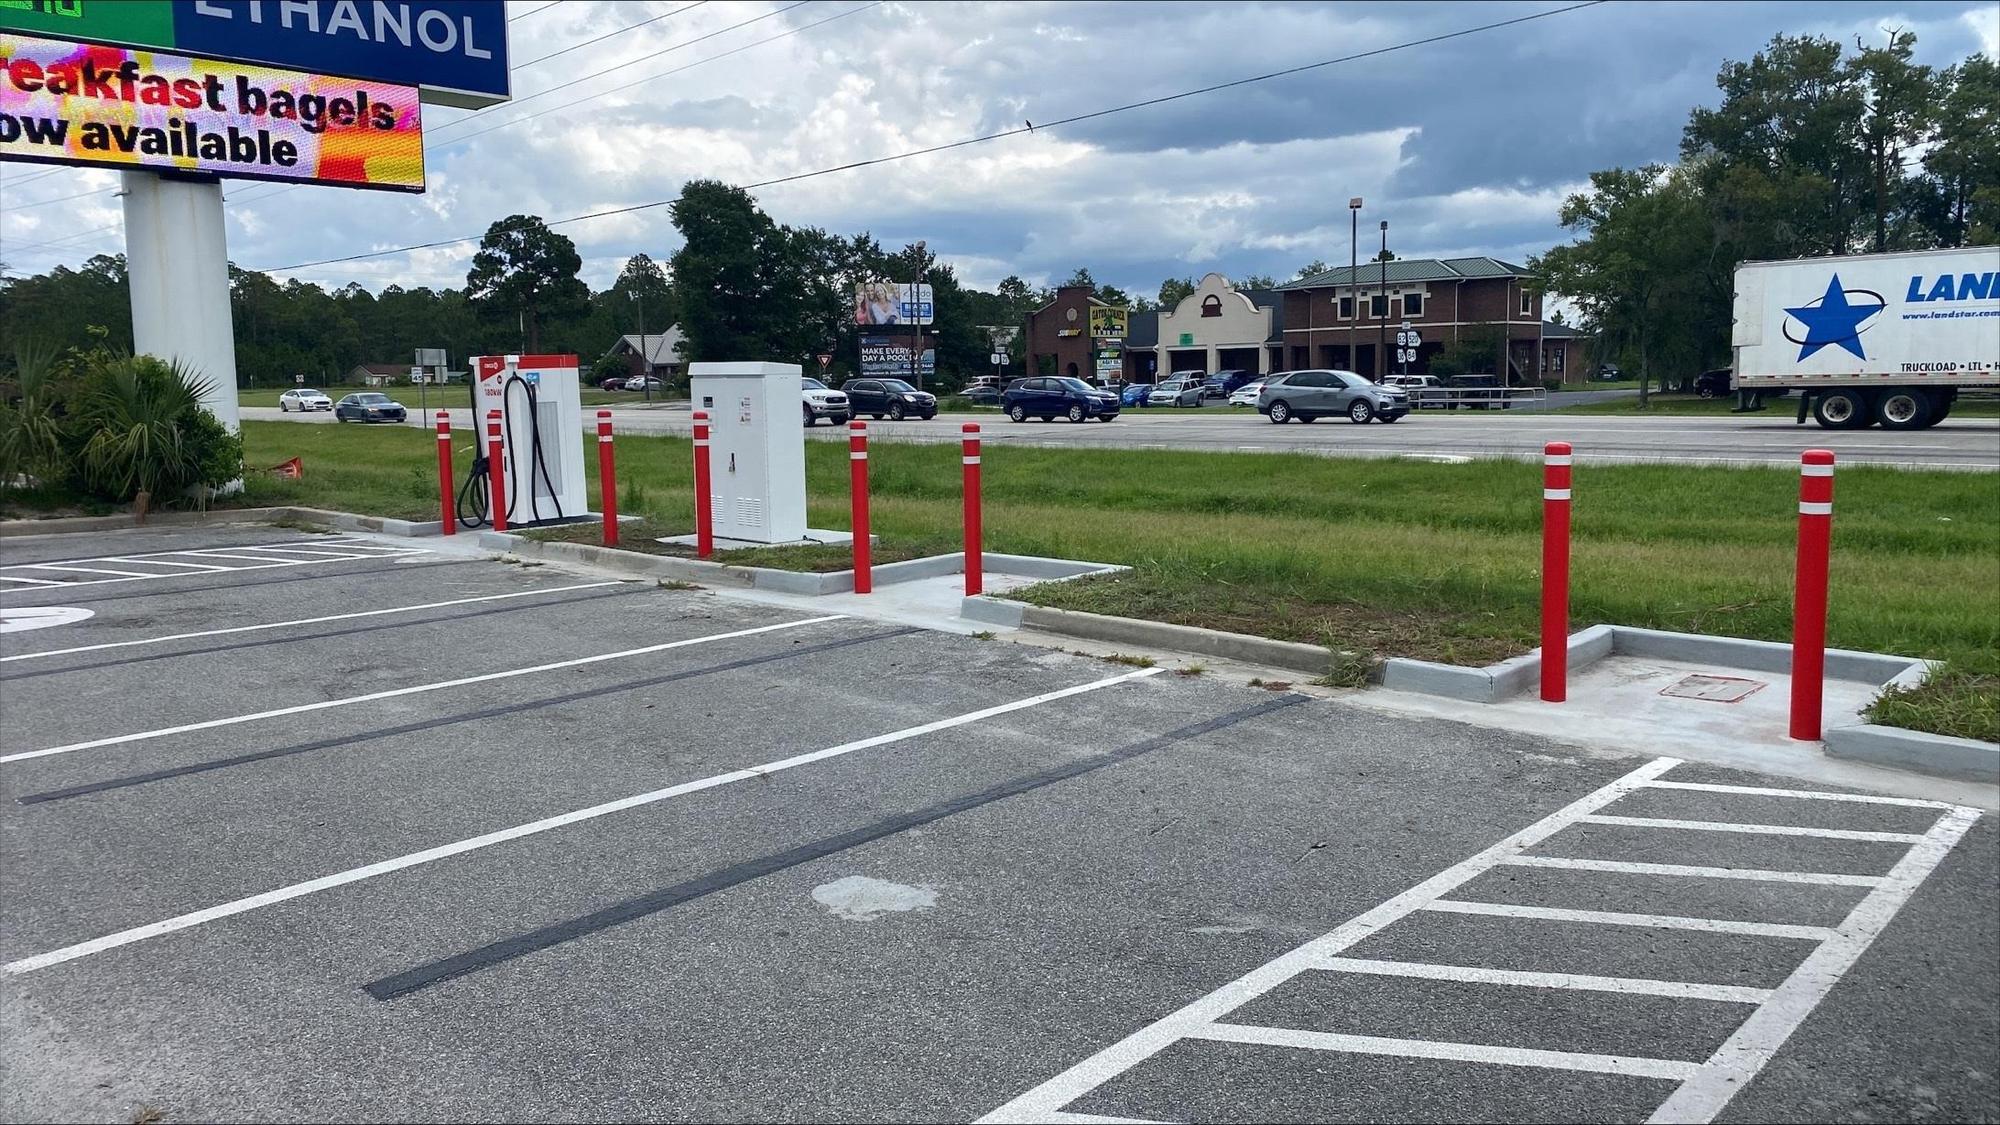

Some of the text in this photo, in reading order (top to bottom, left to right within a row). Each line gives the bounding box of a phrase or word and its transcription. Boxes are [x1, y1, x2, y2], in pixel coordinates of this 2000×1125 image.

[236, 75, 396, 134] bagels
[81, 117, 298, 167] available
[861, 347, 909, 355] MAKE EVERY
[862, 354, 878, 362] DAY
[1900, 362, 1957, 373] TRUCKLOAD
[1968, 361, 1983, 371] LTL
